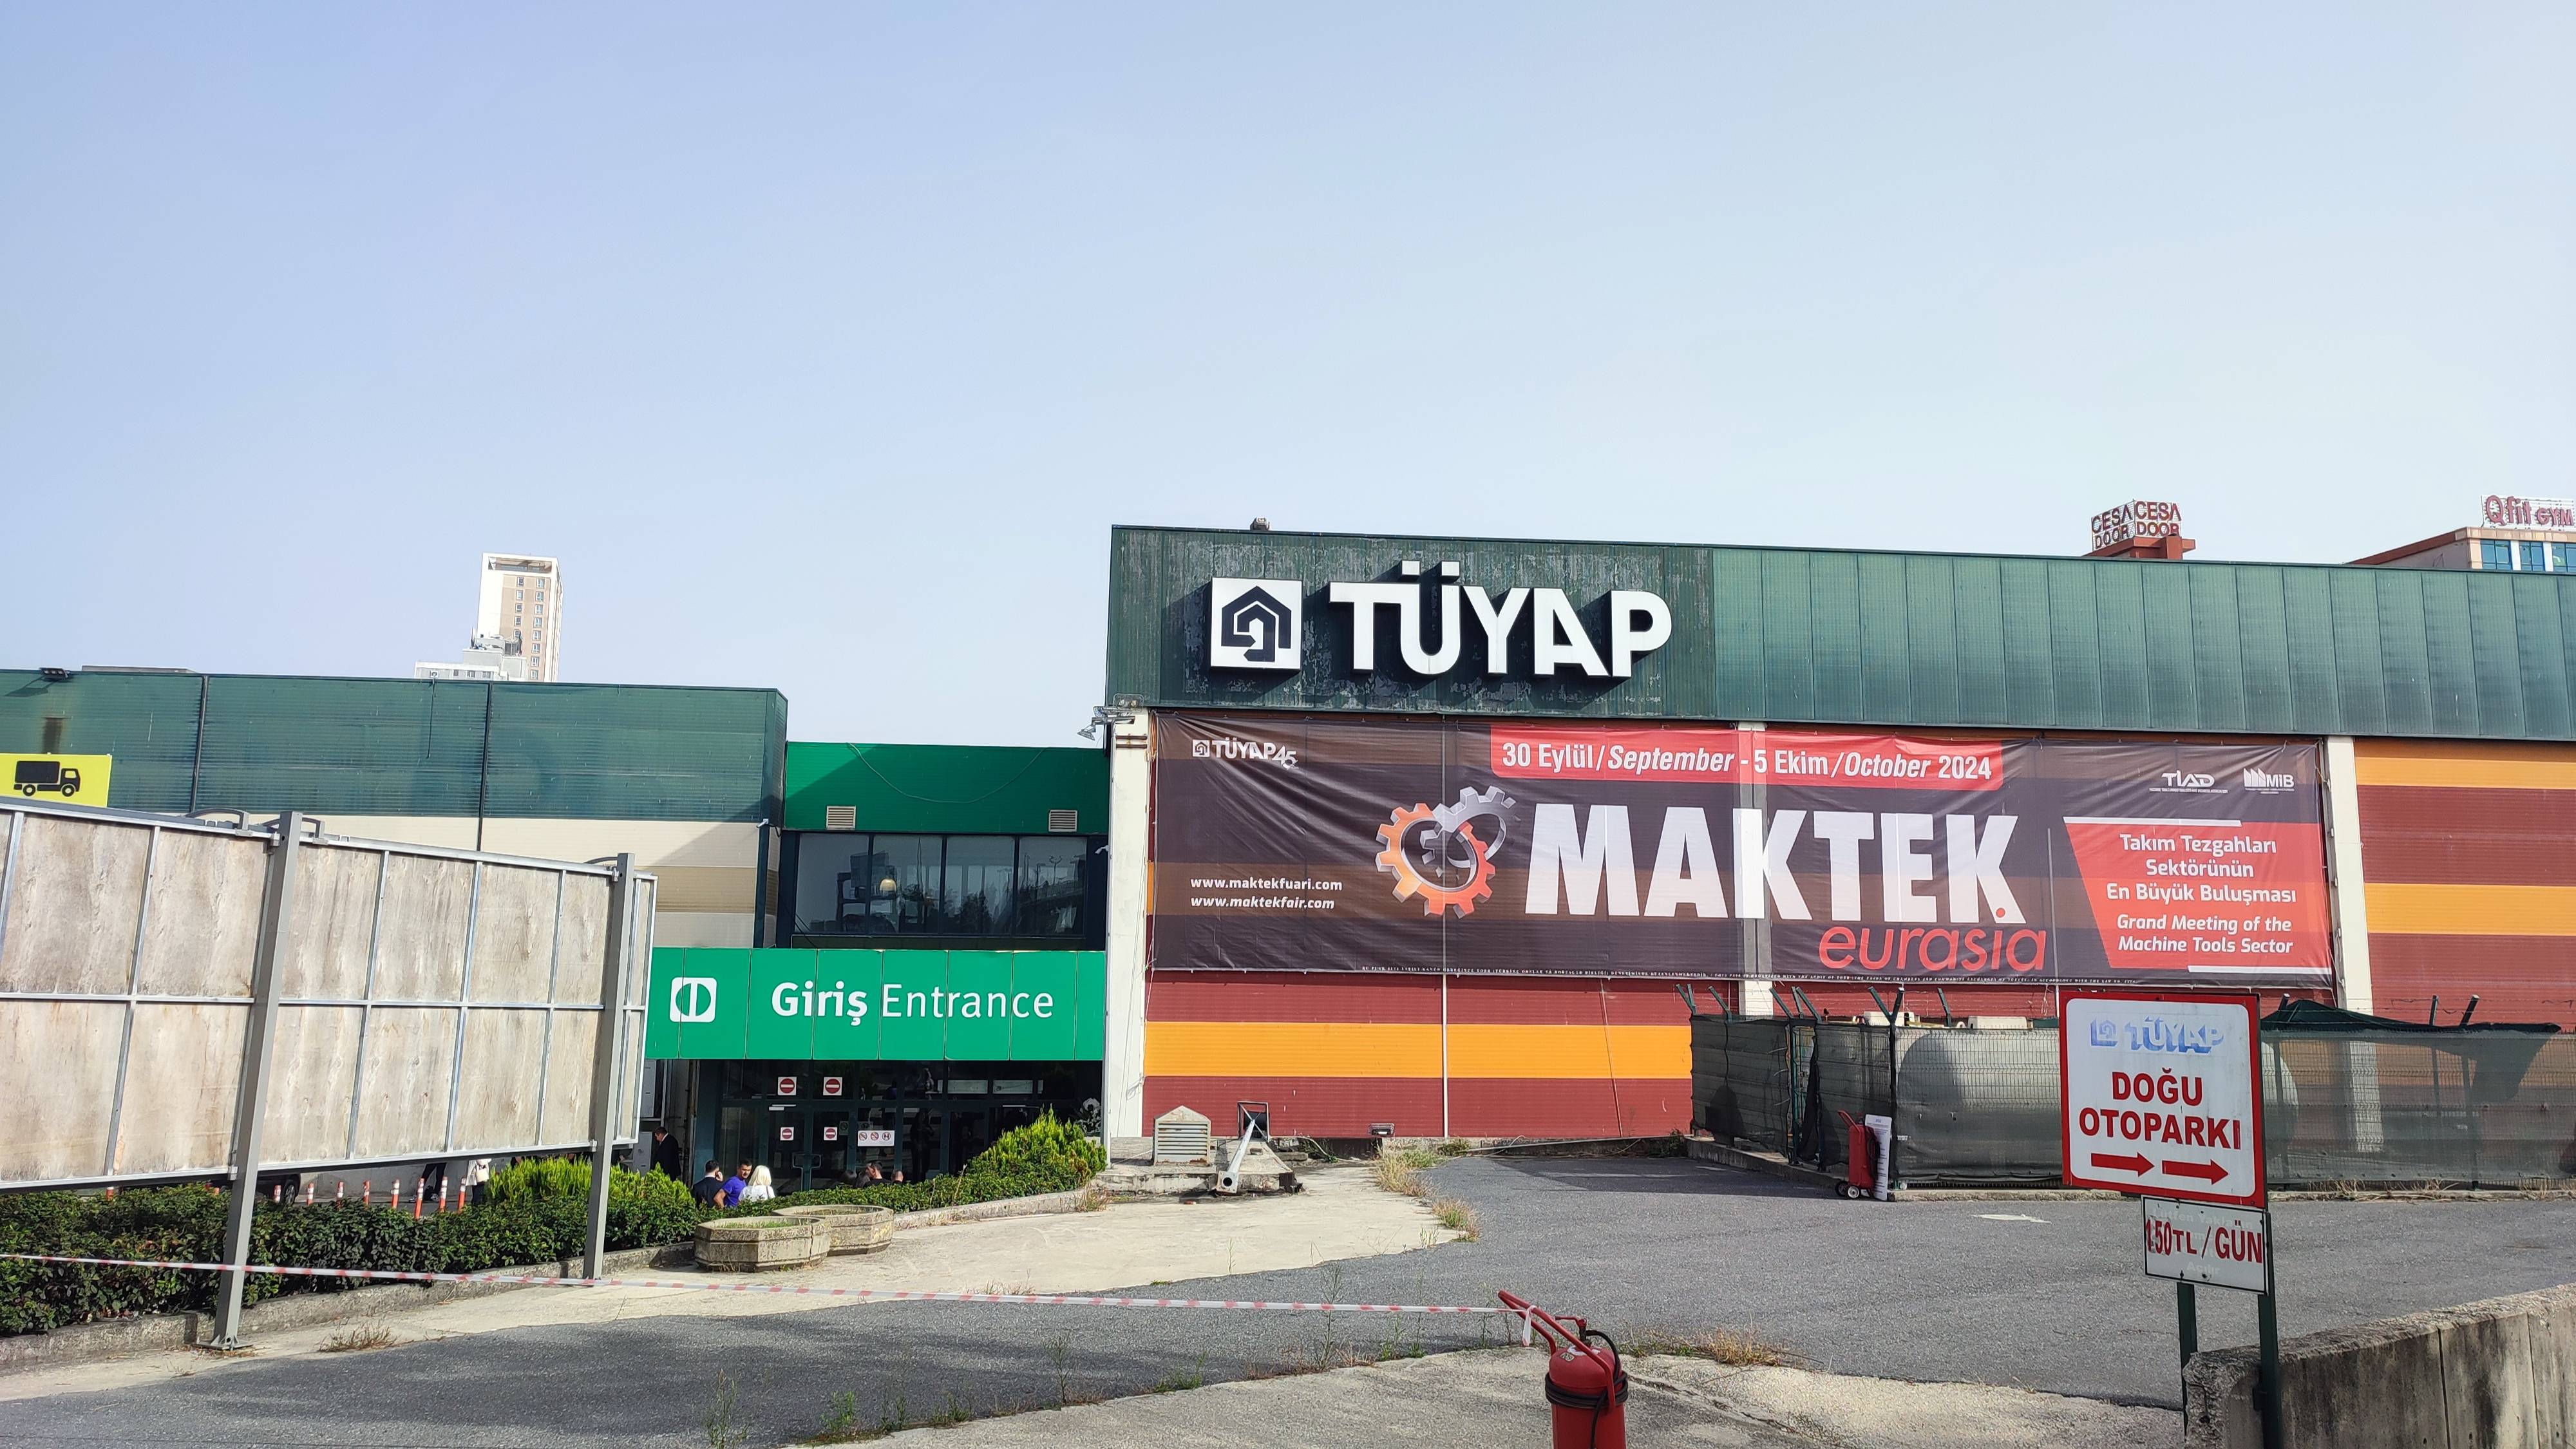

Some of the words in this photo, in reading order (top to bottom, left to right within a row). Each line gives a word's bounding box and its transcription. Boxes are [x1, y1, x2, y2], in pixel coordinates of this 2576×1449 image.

[2486, 495, 2532, 526] Qfit
[2536, 507, 2574, 526] GYM
[2095, 524, 2130, 548] DOOR
[1329, 560, 1673, 677] TÜYAP
[1502, 743, 1530, 767] 30
[1754, 749, 1768, 773] 5
[1938, 755, 1992, 780] 2024
[2119, 833, 2175, 851] Takım
[2180, 835, 2277, 857] Tezgahları
[1524, 802, 2027, 924] MAKTEK
[2145, 858, 2254, 878] Sektörünün
[1190, 876, 1343, 891] www.maktekfuari.com
[2107, 882, 2130, 900] En
[2136, 882, 2195, 905] Büyük
[2200, 884, 2297, 905] Buluşması
[1191, 896, 1335, 909] www.maktekfair.com
[1819, 907, 2047, 971] eurasia
[2117, 914, 2166, 931] Grand
[2171, 914, 2238, 934] Meeting
[2242, 916, 2260, 931] of
[2264, 917, 2292, 933] the
[2118, 936, 2187, 952] Machine
[2192, 937, 2236, 953] Tools
[2240, 938, 2294, 954] Sector
[772, 980, 868, 1026] Giriş
[882, 983, 1054, 1019] Entrance
[2125, 1016, 2224, 1054] TÜYAP
[2112, 1067, 2203, 1106] DOĞU
[2079, 1107, 2241, 1150] OTOPARKI
